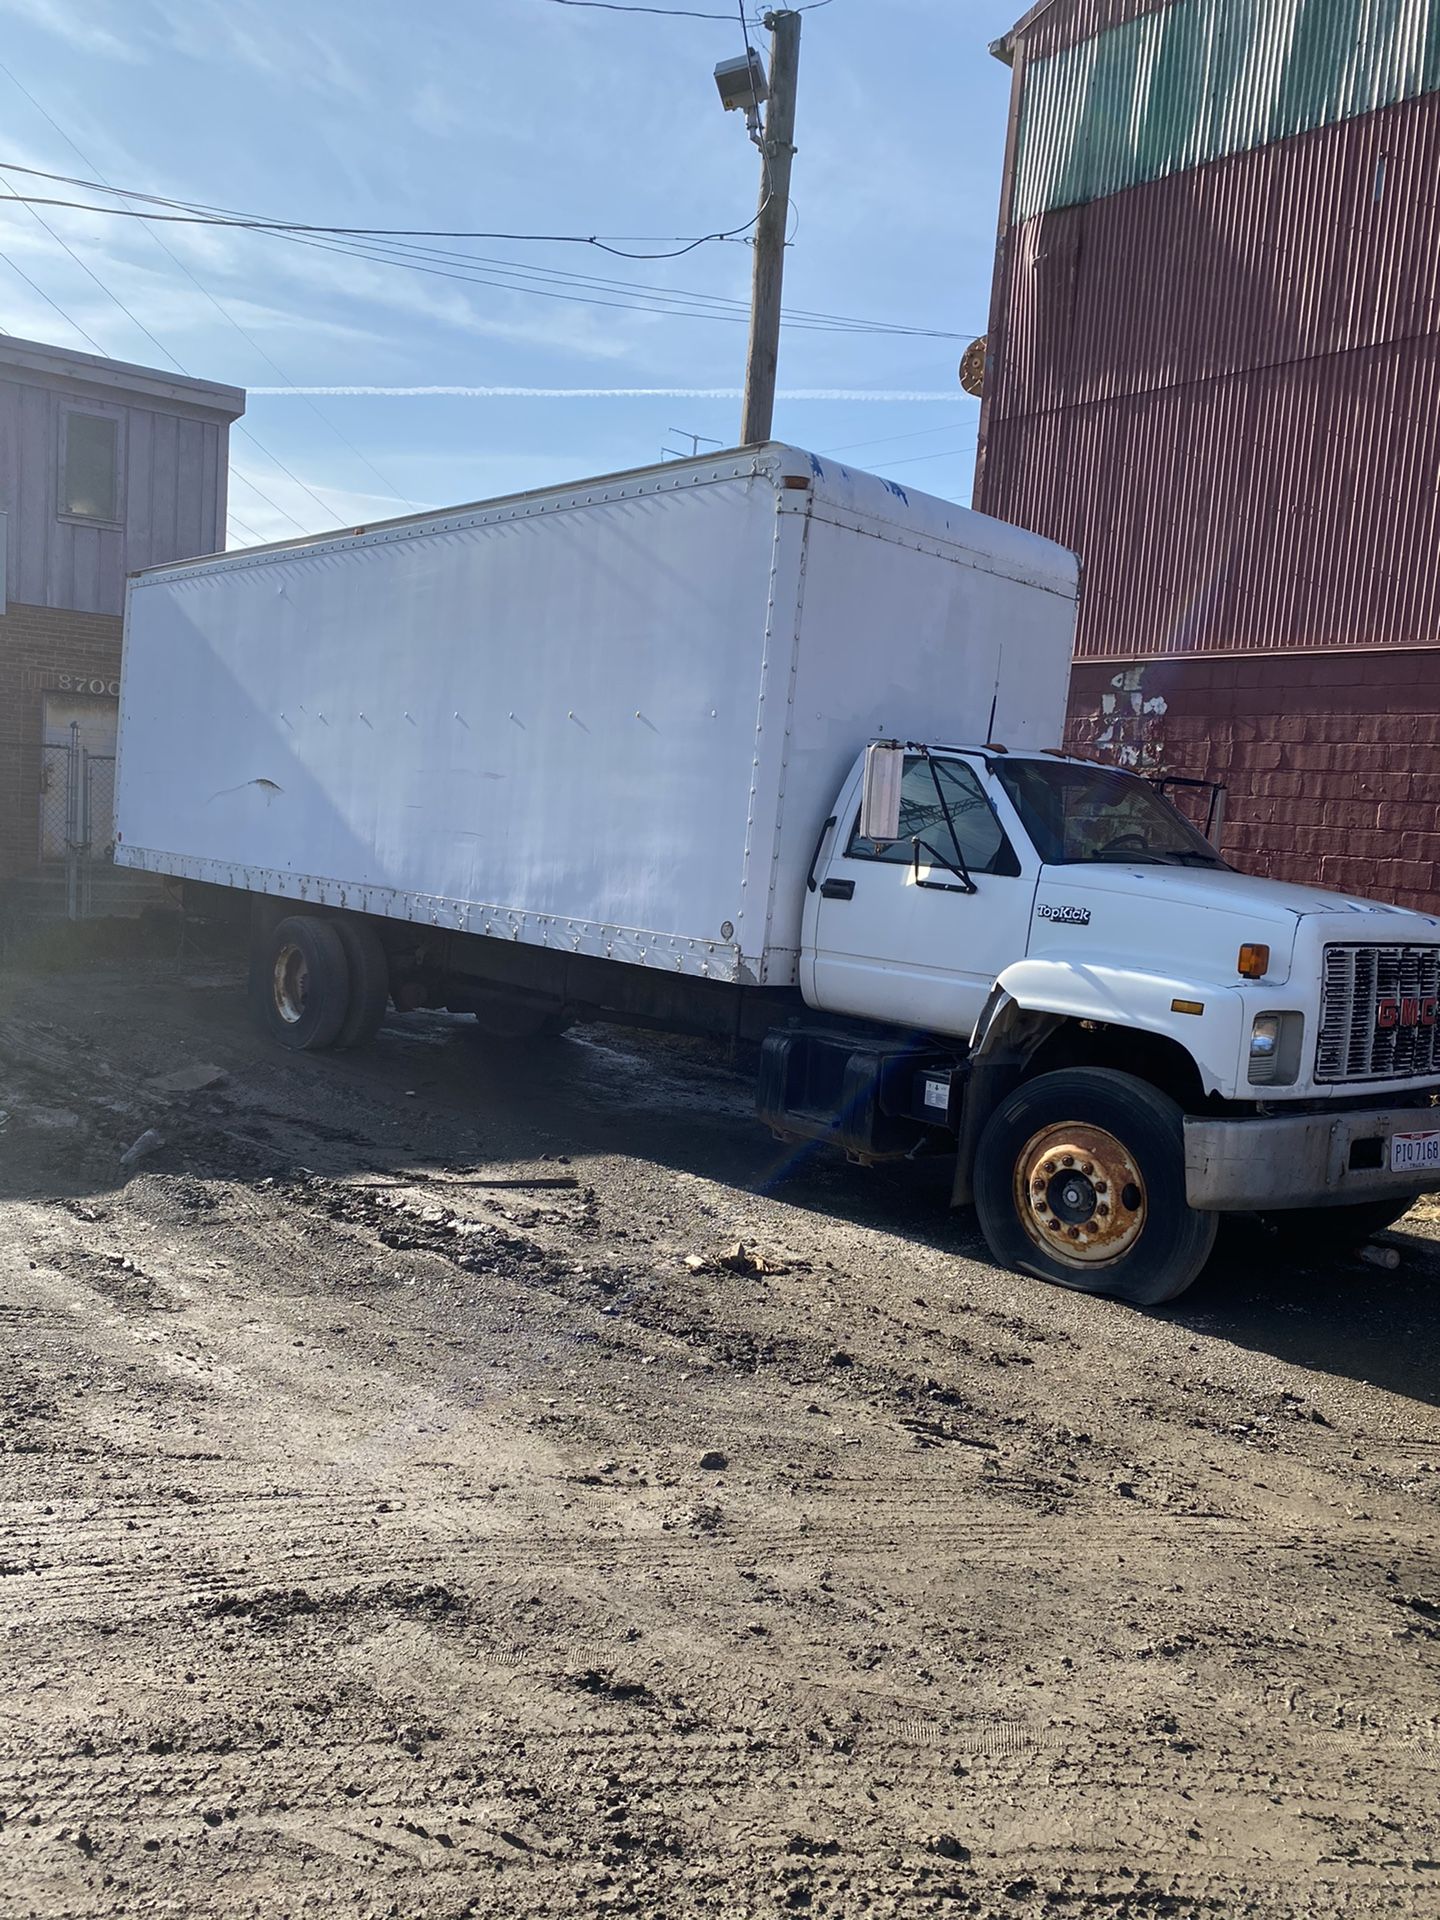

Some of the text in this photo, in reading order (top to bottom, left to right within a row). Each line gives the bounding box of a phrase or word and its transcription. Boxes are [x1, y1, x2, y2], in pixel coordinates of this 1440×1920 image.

[59, 673, 120, 696] 8700
[1038, 904, 1090, 921] TopKick
[1378, 997, 1437, 1027] GMC
[1416, 1141, 1439, 1160] 7168
